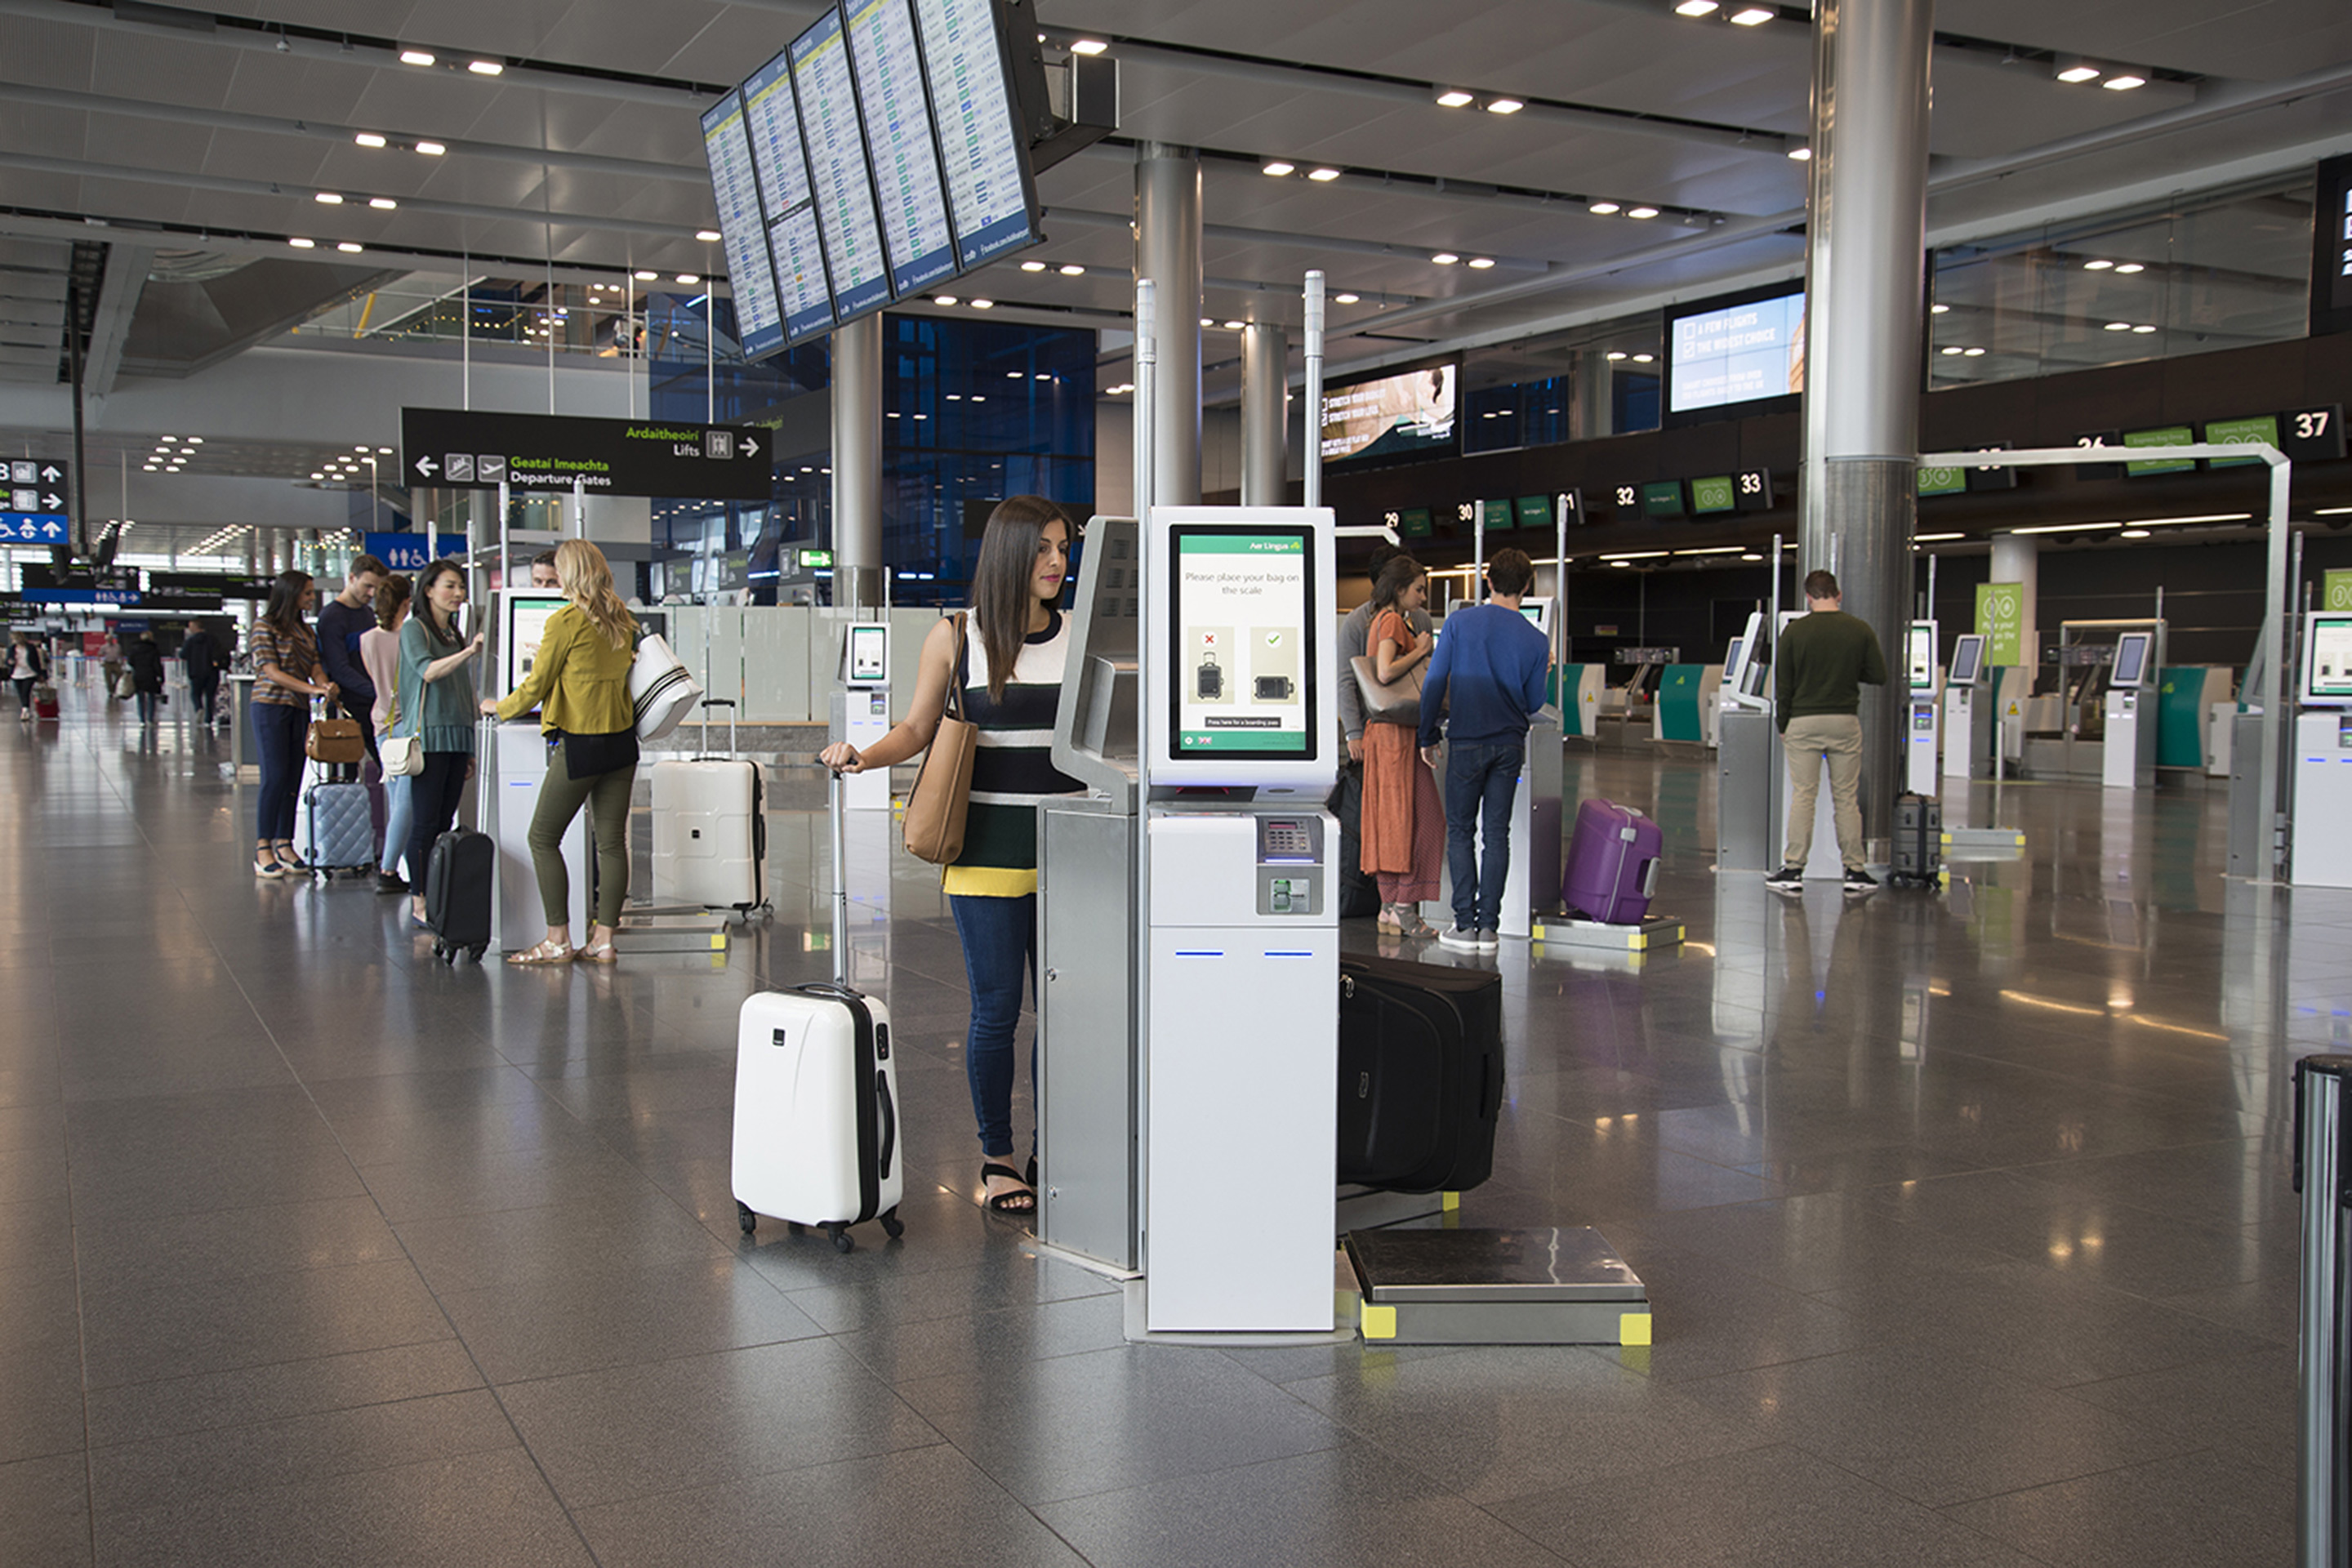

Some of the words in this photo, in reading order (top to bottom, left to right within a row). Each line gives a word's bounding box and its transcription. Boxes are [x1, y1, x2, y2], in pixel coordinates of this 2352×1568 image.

[1723, 312, 1758, 331] FLIGHTS
[1696, 339, 1713, 354] THE
[1744, 327, 1775, 344] CHOICE
[2215, 426, 2238, 435] Express
[2239, 425, 2251, 434] Bag
[2252, 424, 2269, 432] Drop
[2295, 412, 2329, 439] 37
[626, 426, 699, 441] Ardaitheoirí
[2169, 434, 2185, 442] Drop
[673, 443, 700, 457] Lifts
[510, 457, 552, 469] Geataí
[555, 458, 609, 471] Imeachta
[510, 471, 573, 486] Departure
[576, 474, 612, 486] Gates
[1740, 473, 1762, 493] 33
[1616, 487, 1635, 506] 32
[1458, 503, 1473, 521] 30
[1384, 512, 1399, 528] 29
[1263, 542, 1289, 551] Lingus
[1185, 572, 1214, 581] Please
[1217, 572, 1241, 583] place
[1243, 574, 1264, 583] your
[1267, 572, 1285, 583] bag
[1222, 586, 1237, 595] the
[1240, 586, 1263, 595] scale
